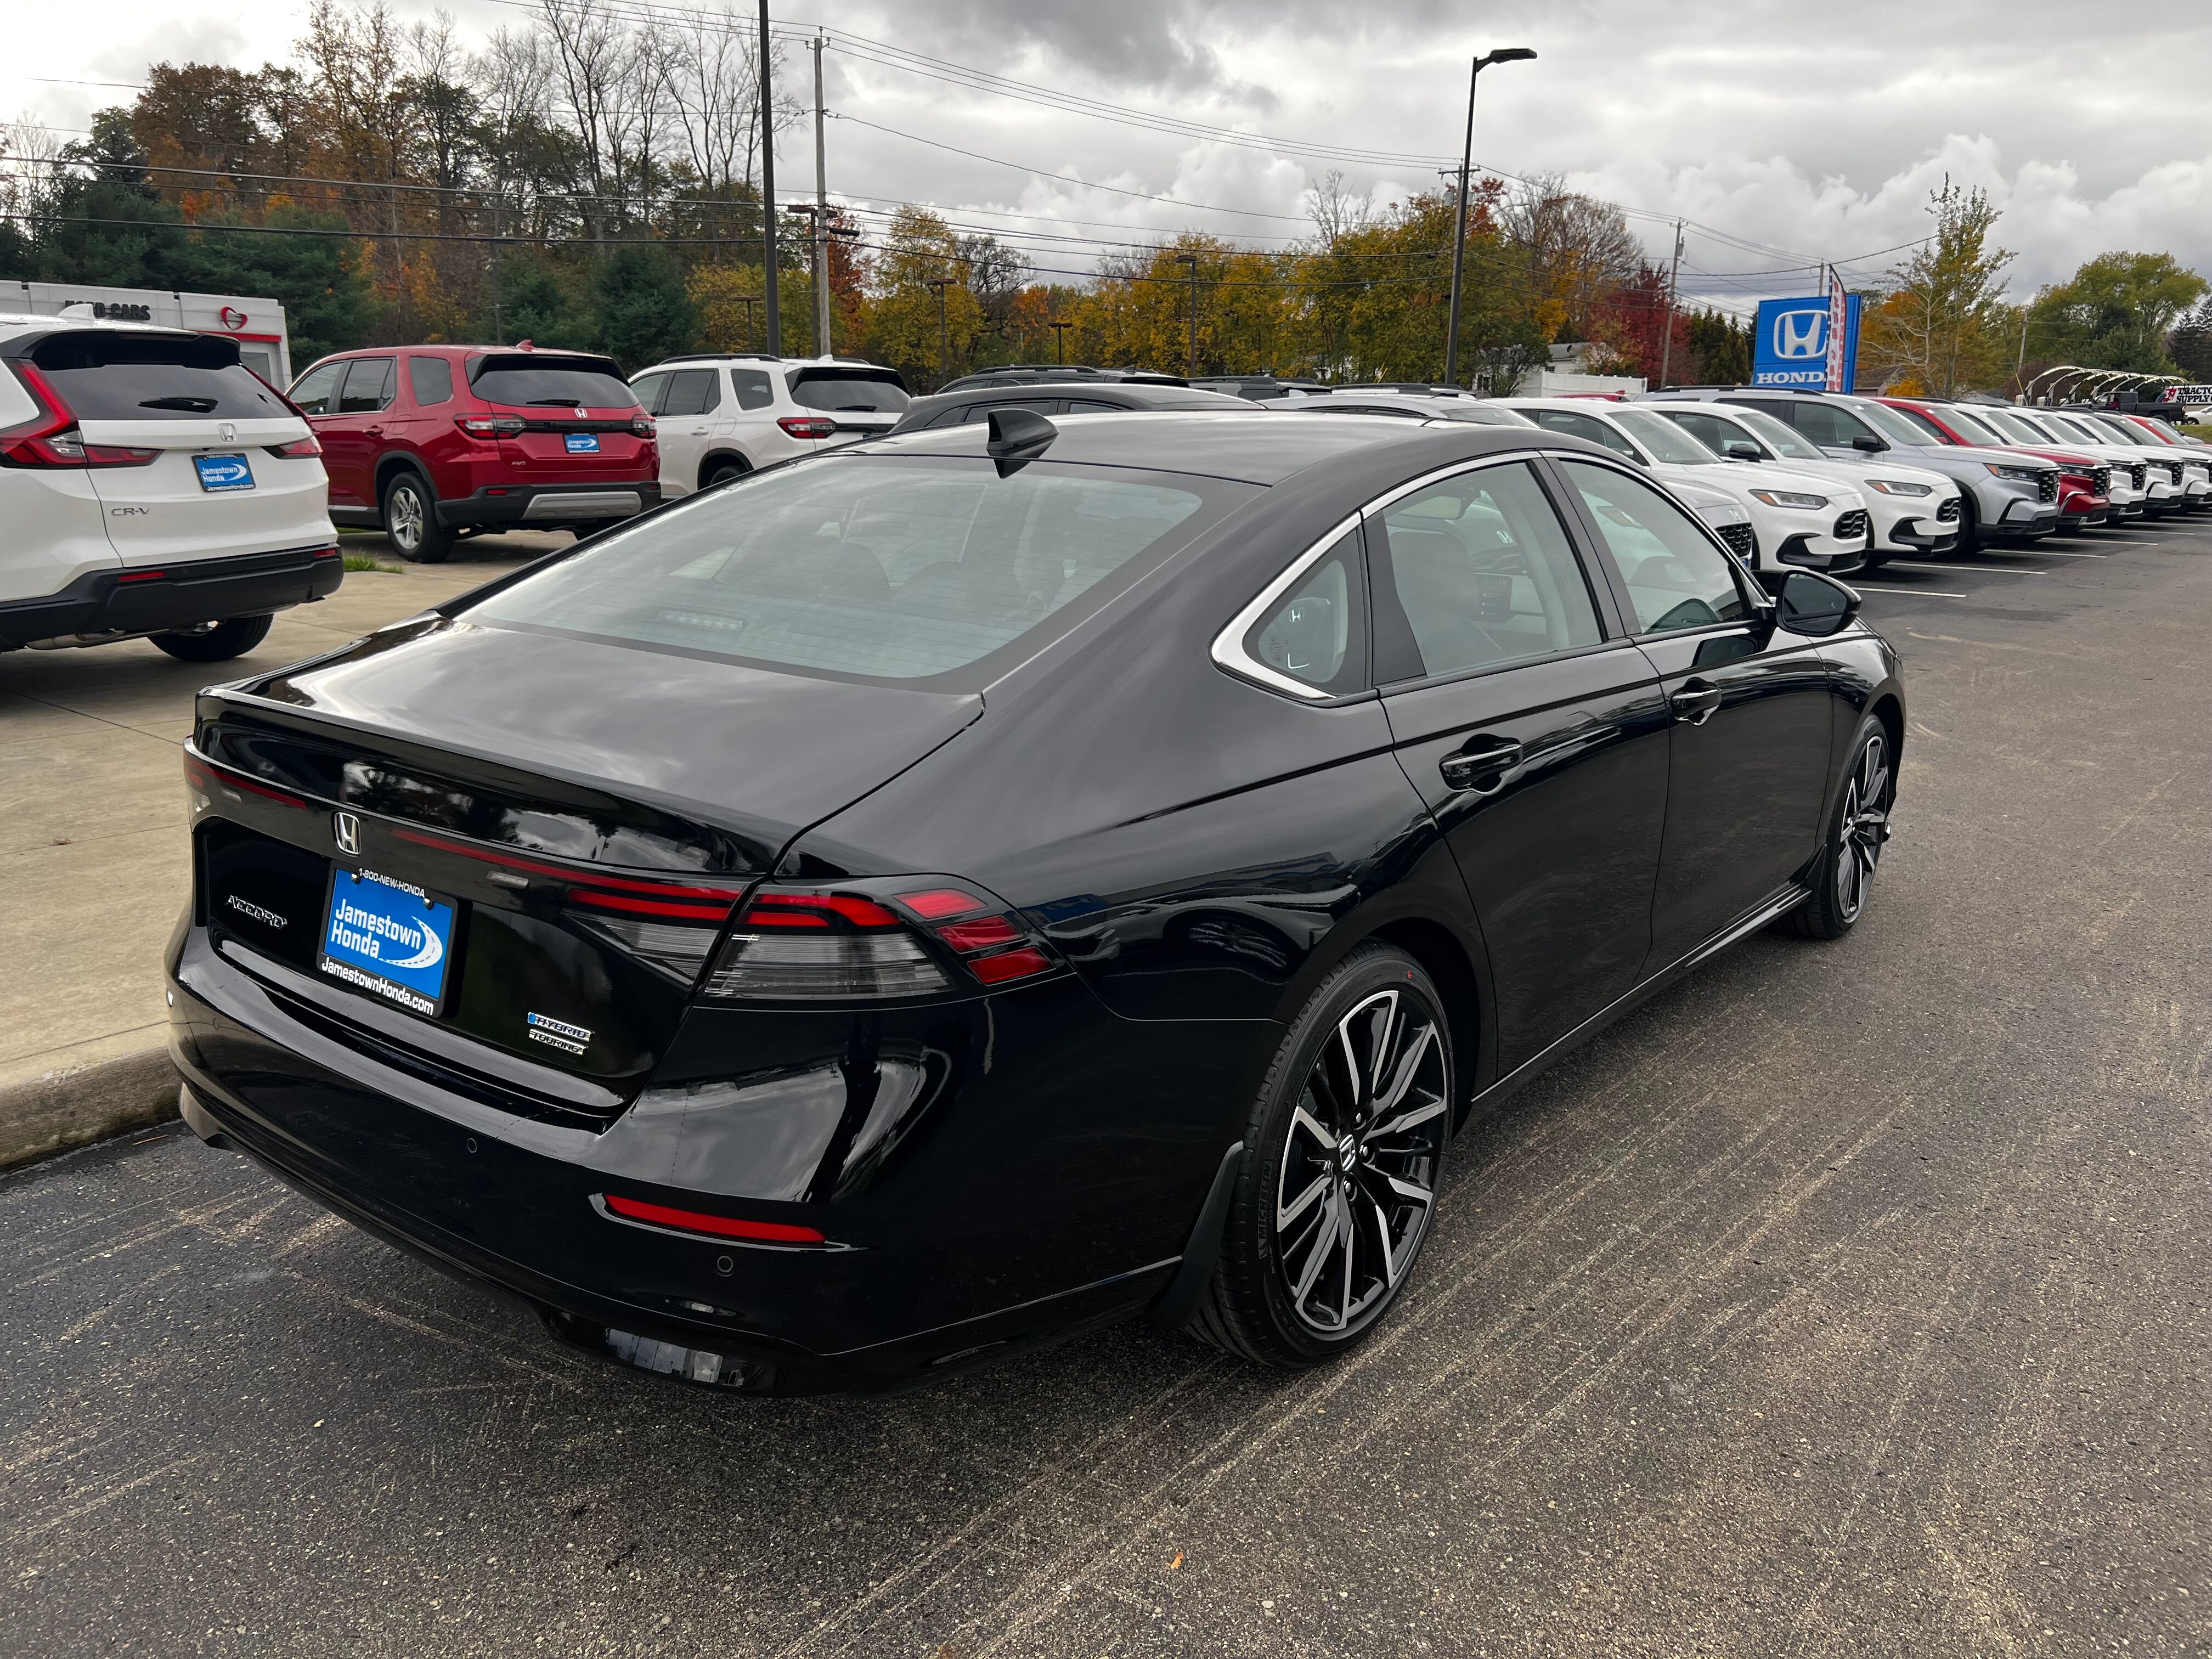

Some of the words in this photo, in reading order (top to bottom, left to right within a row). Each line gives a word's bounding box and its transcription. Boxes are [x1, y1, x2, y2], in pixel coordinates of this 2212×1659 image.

[111, 303, 150, 320] CARS
[1756, 371, 1826, 384] HOND
[201, 466, 239, 475] Jamestown
[202, 475, 225, 483] Honda
[111, 507, 150, 516] CR-V
[358, 867, 426, 899] 1-800-NEW-HONDA
[224, 895, 288, 929] ACCORD
[335, 898, 421, 950] Jamestown
[331, 919, 380, 959] Honda
[321, 956, 434, 1015] JamestownHonda.com
[534, 1015, 586, 1039] HYBRID
[530, 1031, 580, 1053] TOURING
[1258, 1163, 1272, 1240] MICHELIN
